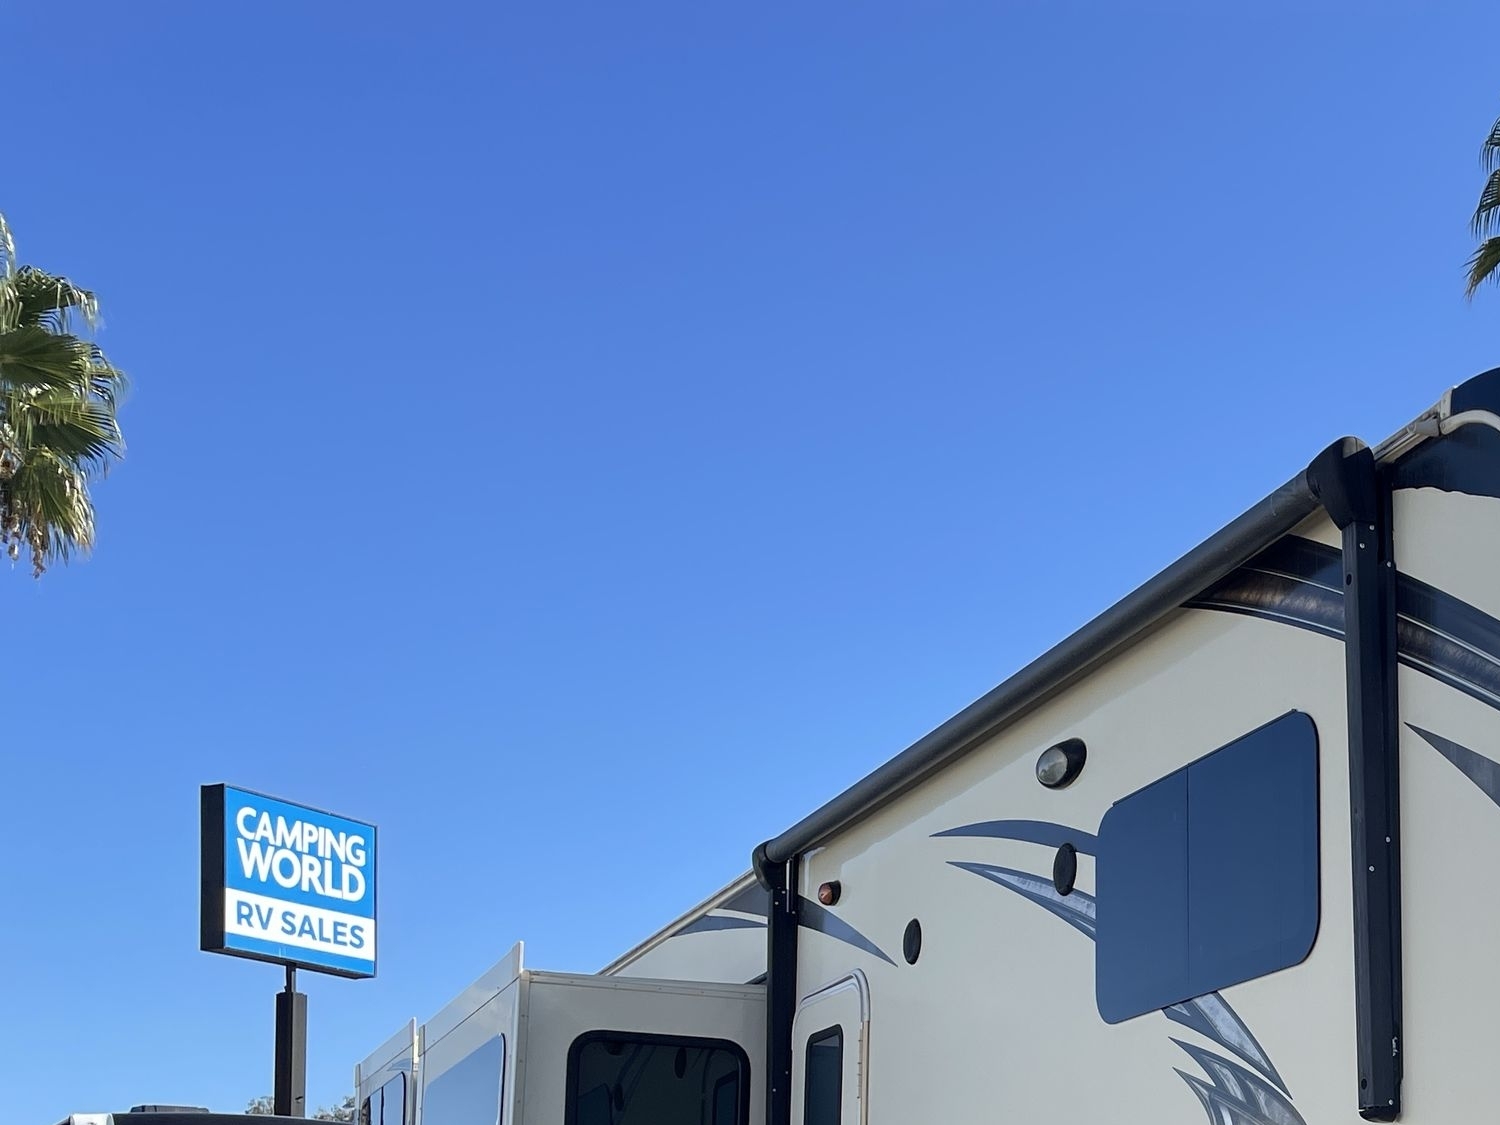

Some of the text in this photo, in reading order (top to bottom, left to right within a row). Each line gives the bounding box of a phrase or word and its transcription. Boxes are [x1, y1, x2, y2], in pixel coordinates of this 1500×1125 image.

[236, 806, 367, 868] CAMPING
[236, 837, 367, 902] WORLD
[236, 900, 366, 949] RV SALES
